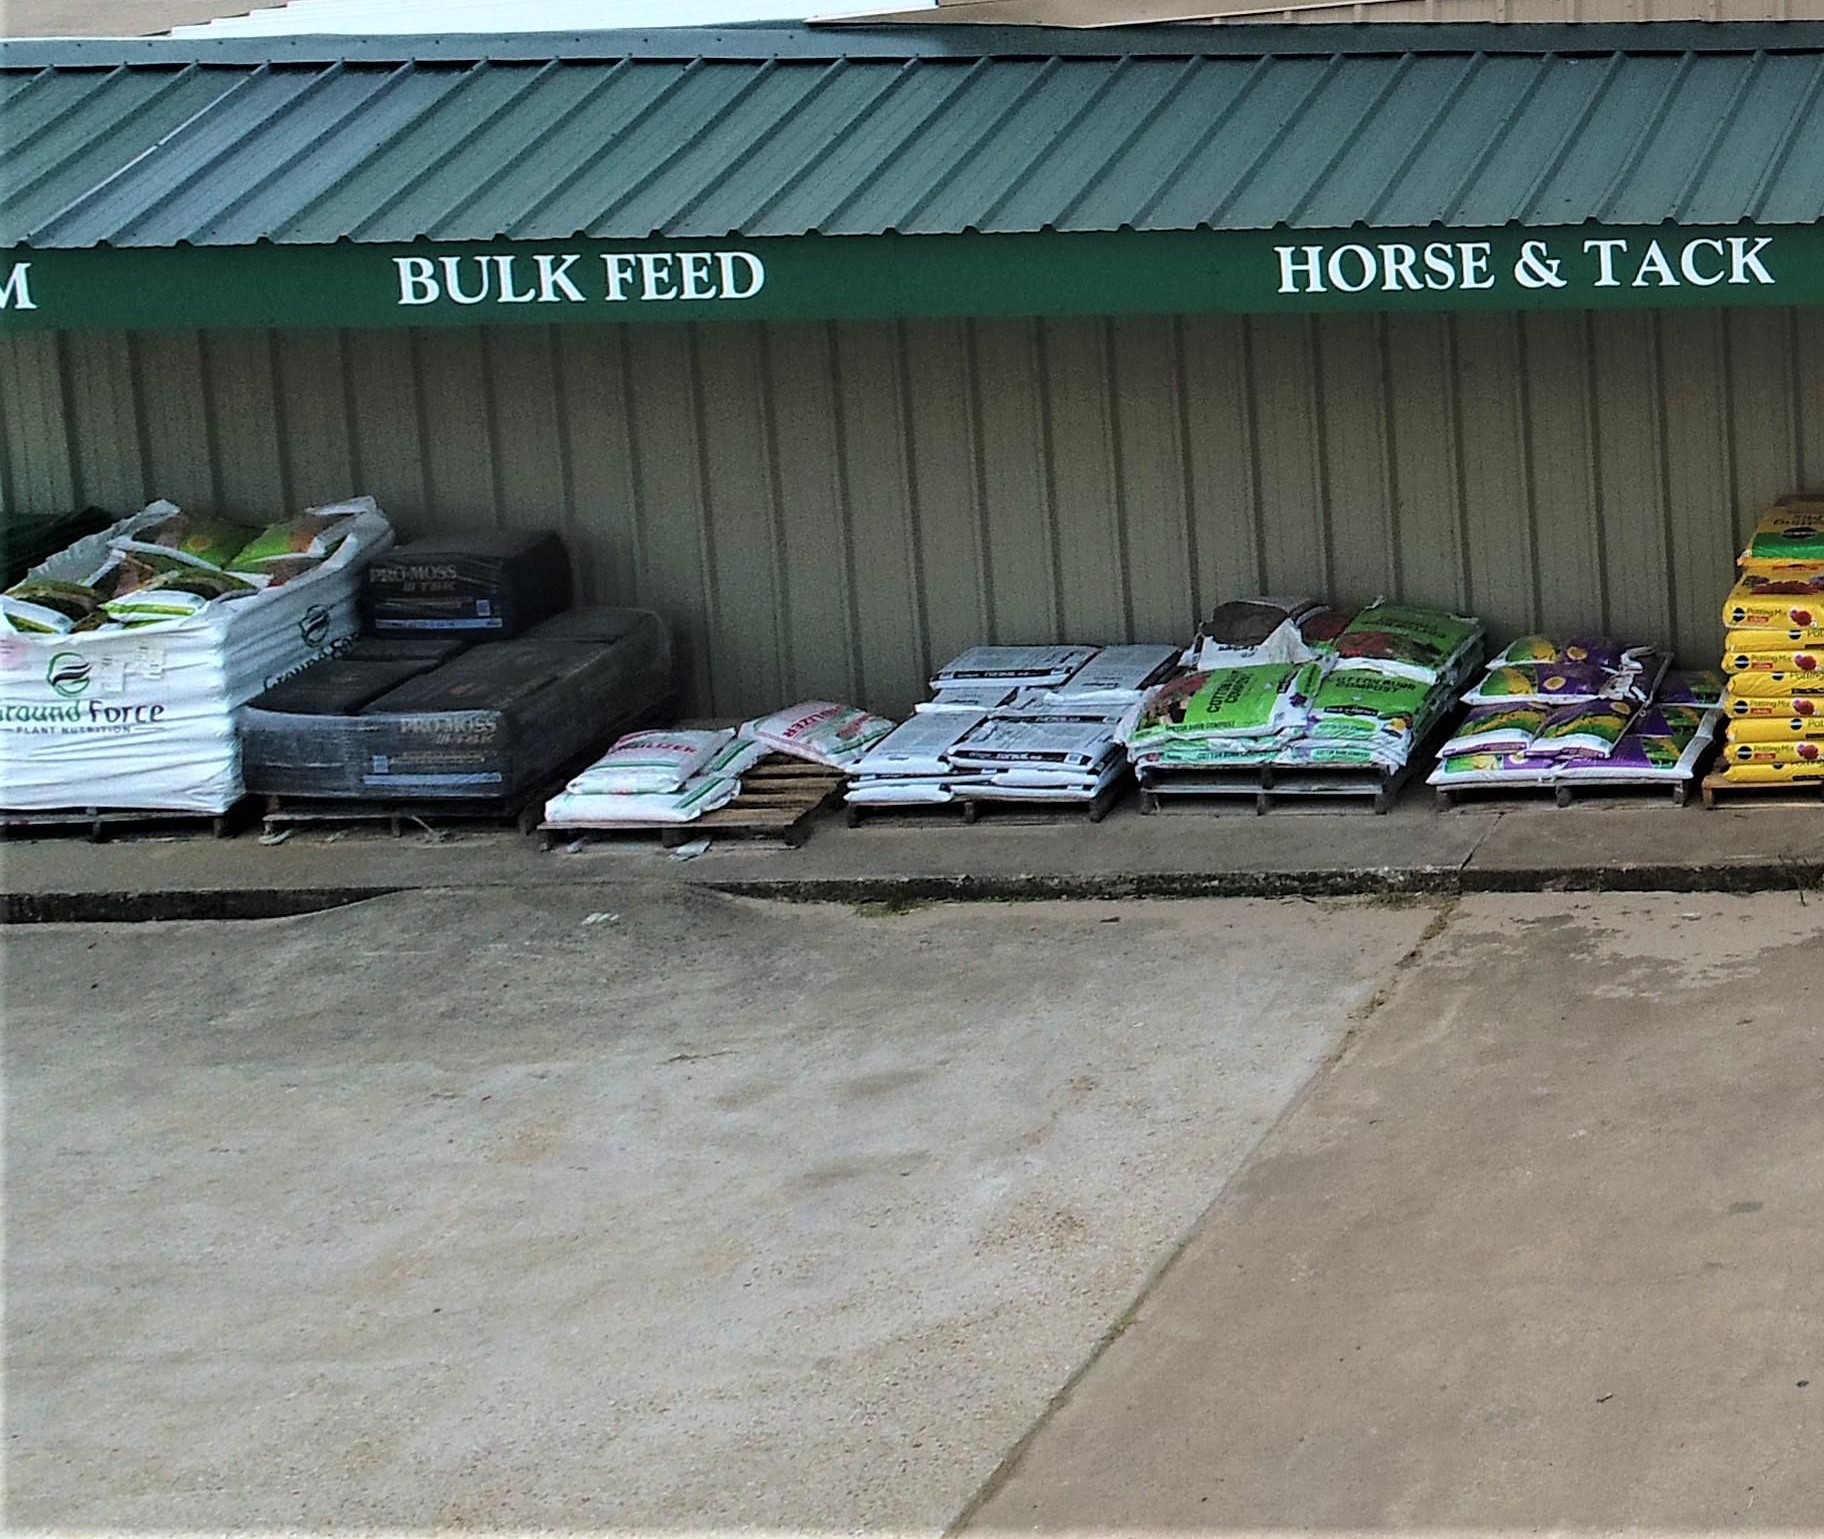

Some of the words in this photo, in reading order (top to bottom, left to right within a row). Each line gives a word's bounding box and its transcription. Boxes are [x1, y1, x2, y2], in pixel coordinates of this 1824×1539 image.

[397, 256, 586, 306] BULK
[600, 251, 765, 301] FEED
[1274, 242, 1495, 293] HORSE
[1514, 240, 1568, 288] &
[1583, 237, 1776, 287] TACK
[88, 699, 165, 723] Force
